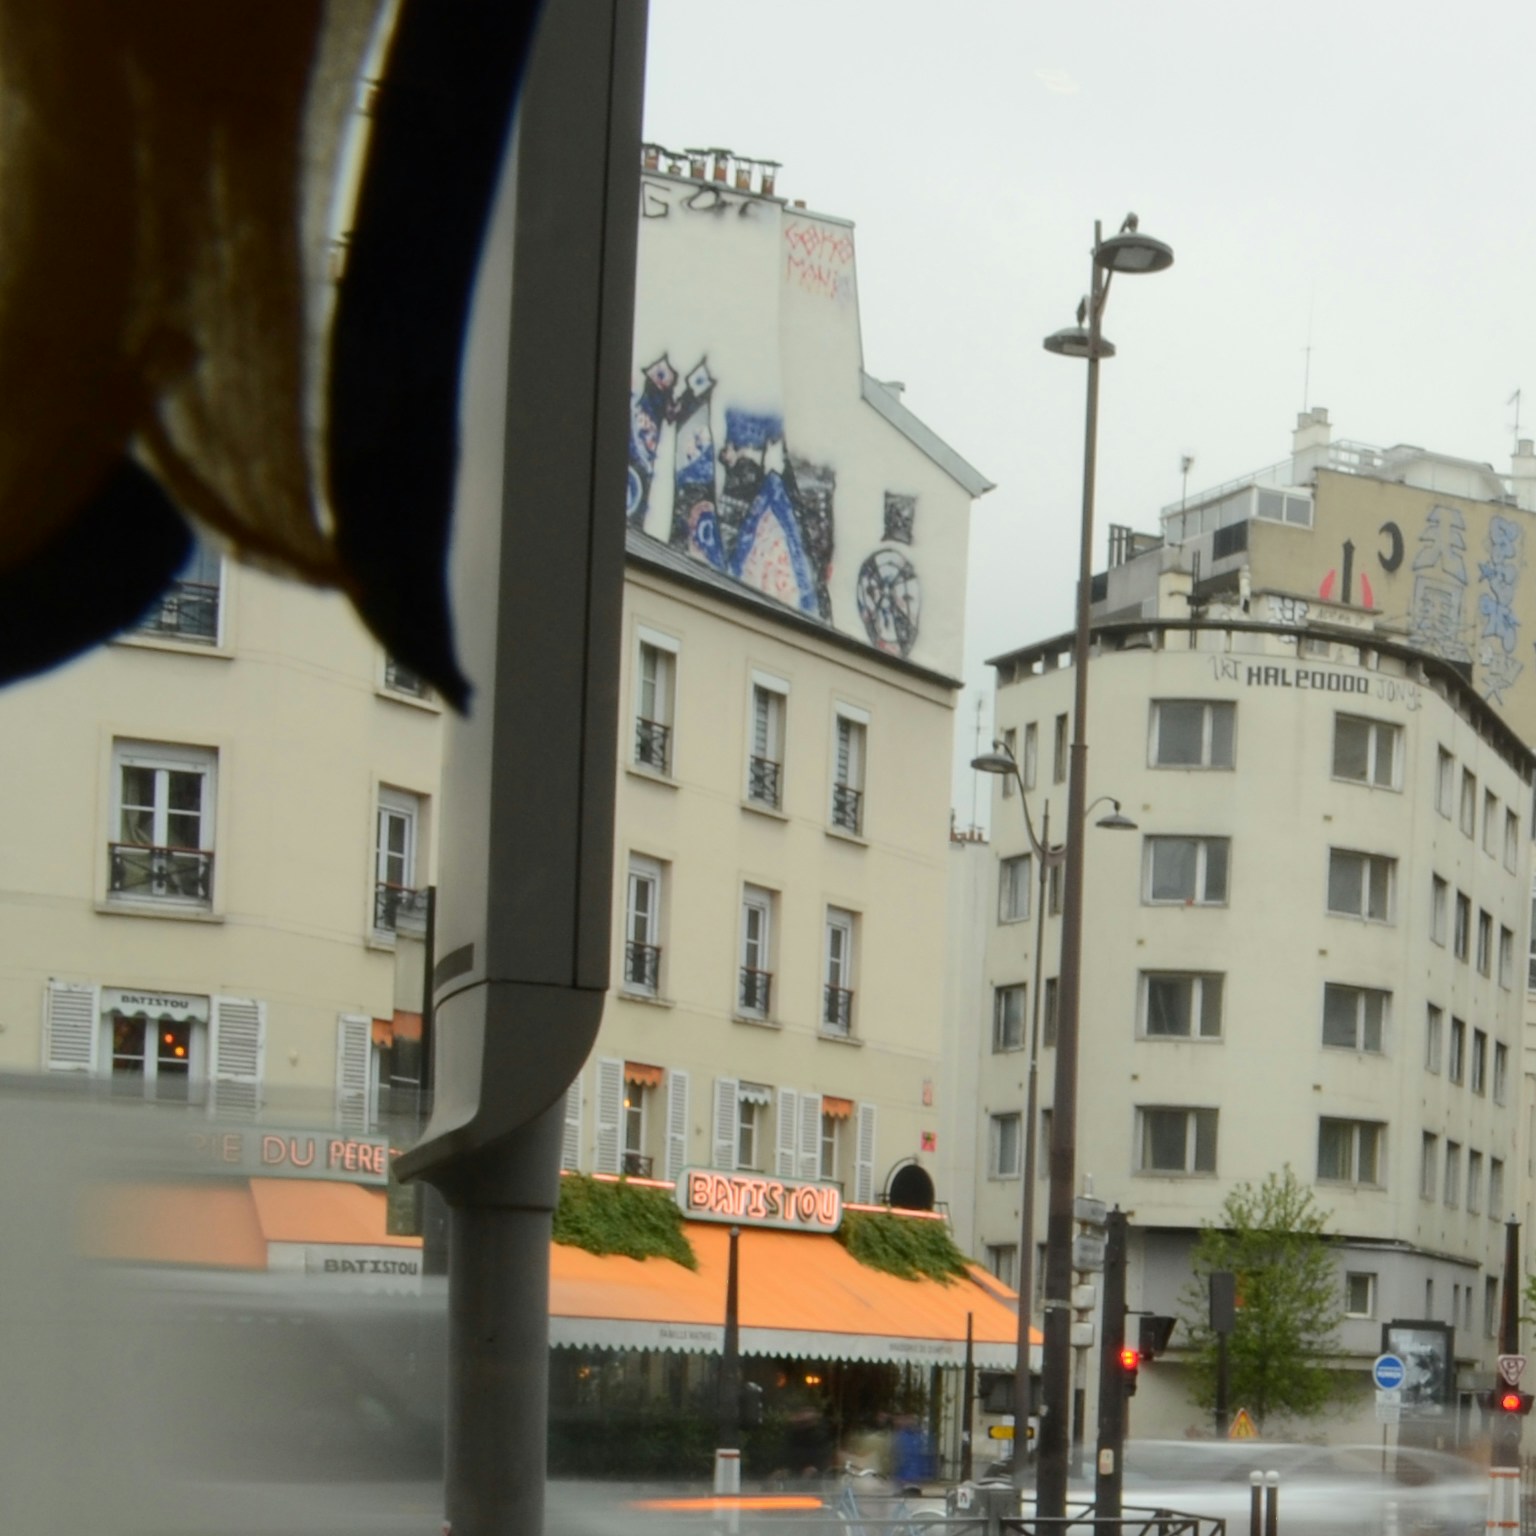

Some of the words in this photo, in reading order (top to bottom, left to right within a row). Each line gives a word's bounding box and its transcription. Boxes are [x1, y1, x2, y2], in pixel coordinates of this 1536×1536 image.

[121, 993, 189, 1010] BATISTOU
[262, 1134, 315, 1168] DU
[328, 1138, 387, 1174] PÈRE
[687, 1171, 841, 1226] BATISTOU
[323, 1257, 419, 1277] BATISTOU
